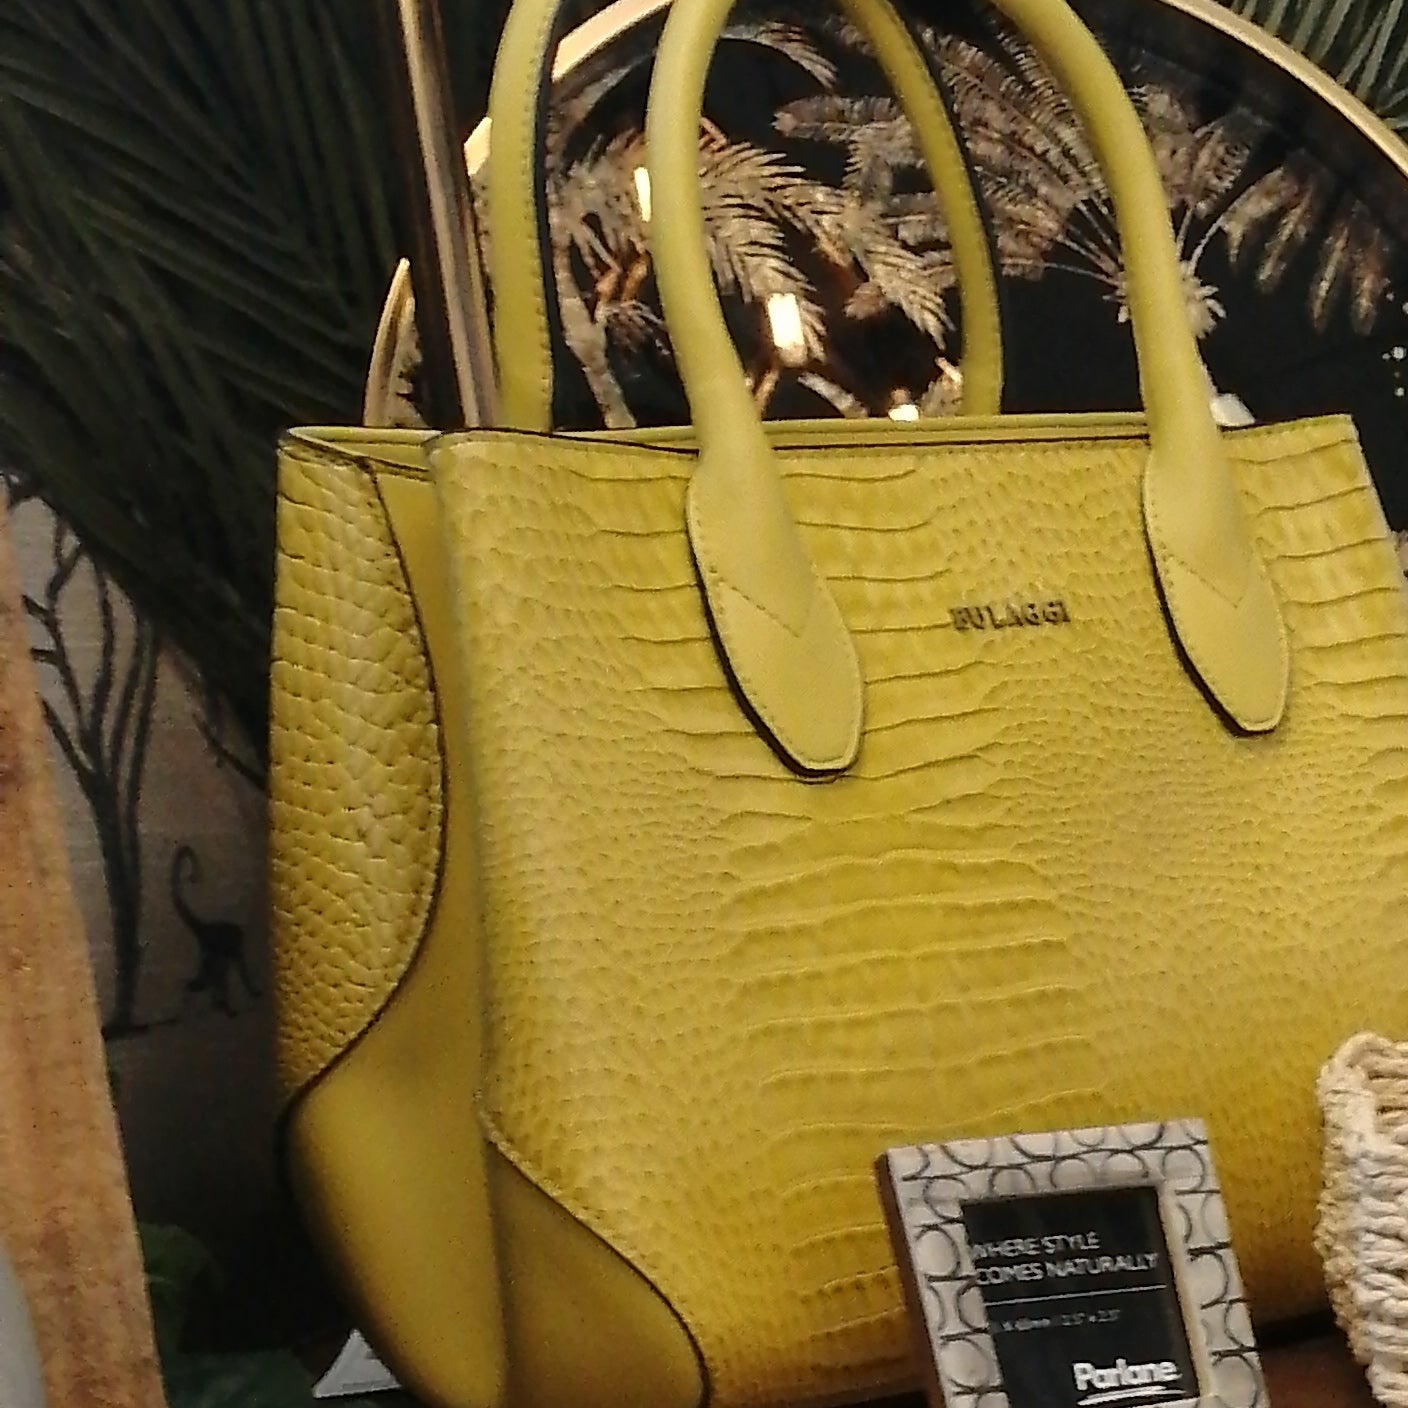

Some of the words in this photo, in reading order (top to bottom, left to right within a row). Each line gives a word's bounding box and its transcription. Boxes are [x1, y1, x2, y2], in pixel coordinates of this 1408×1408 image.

[1041, 1230, 1101, 1254] STYLE
[975, 1261, 1045, 1285] COMES
[1045, 1252, 1160, 1279] NATURALLY
[1072, 1357, 1182, 1390] Parlane
